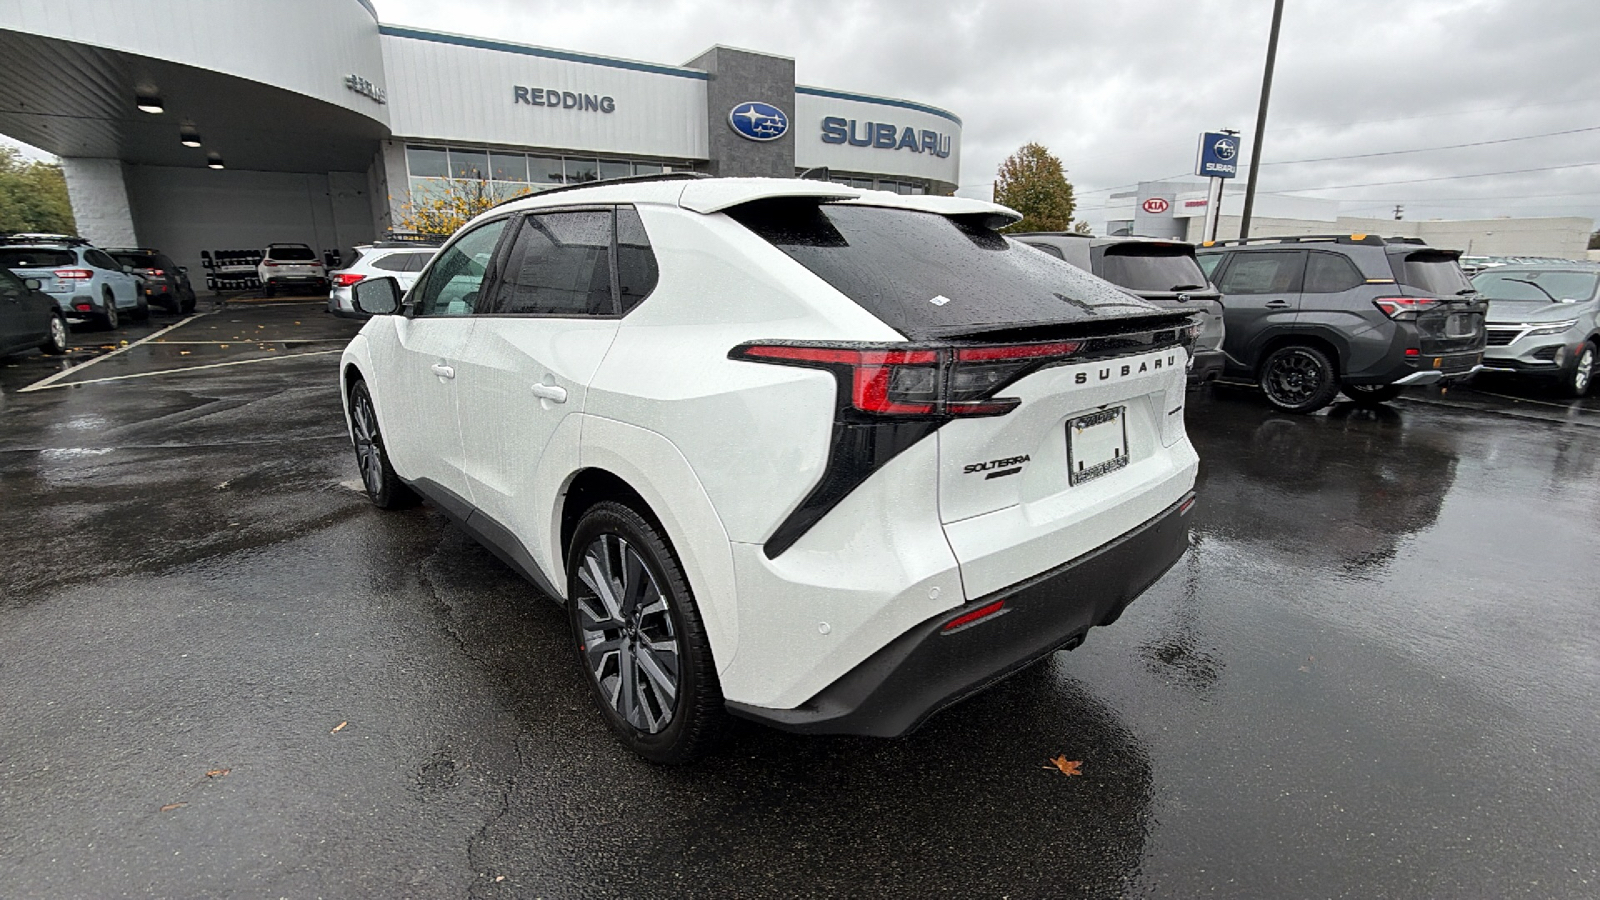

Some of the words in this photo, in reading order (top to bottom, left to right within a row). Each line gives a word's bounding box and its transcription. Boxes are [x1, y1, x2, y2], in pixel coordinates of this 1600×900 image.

[513, 85, 616, 114] REDDING
[821, 116, 951, 159] SUBARU
[1205, 162, 1236, 174] SUBARU
[1074, 355, 1175, 385] SUBARU
[963, 454, 1031, 474] SOLTERRA
